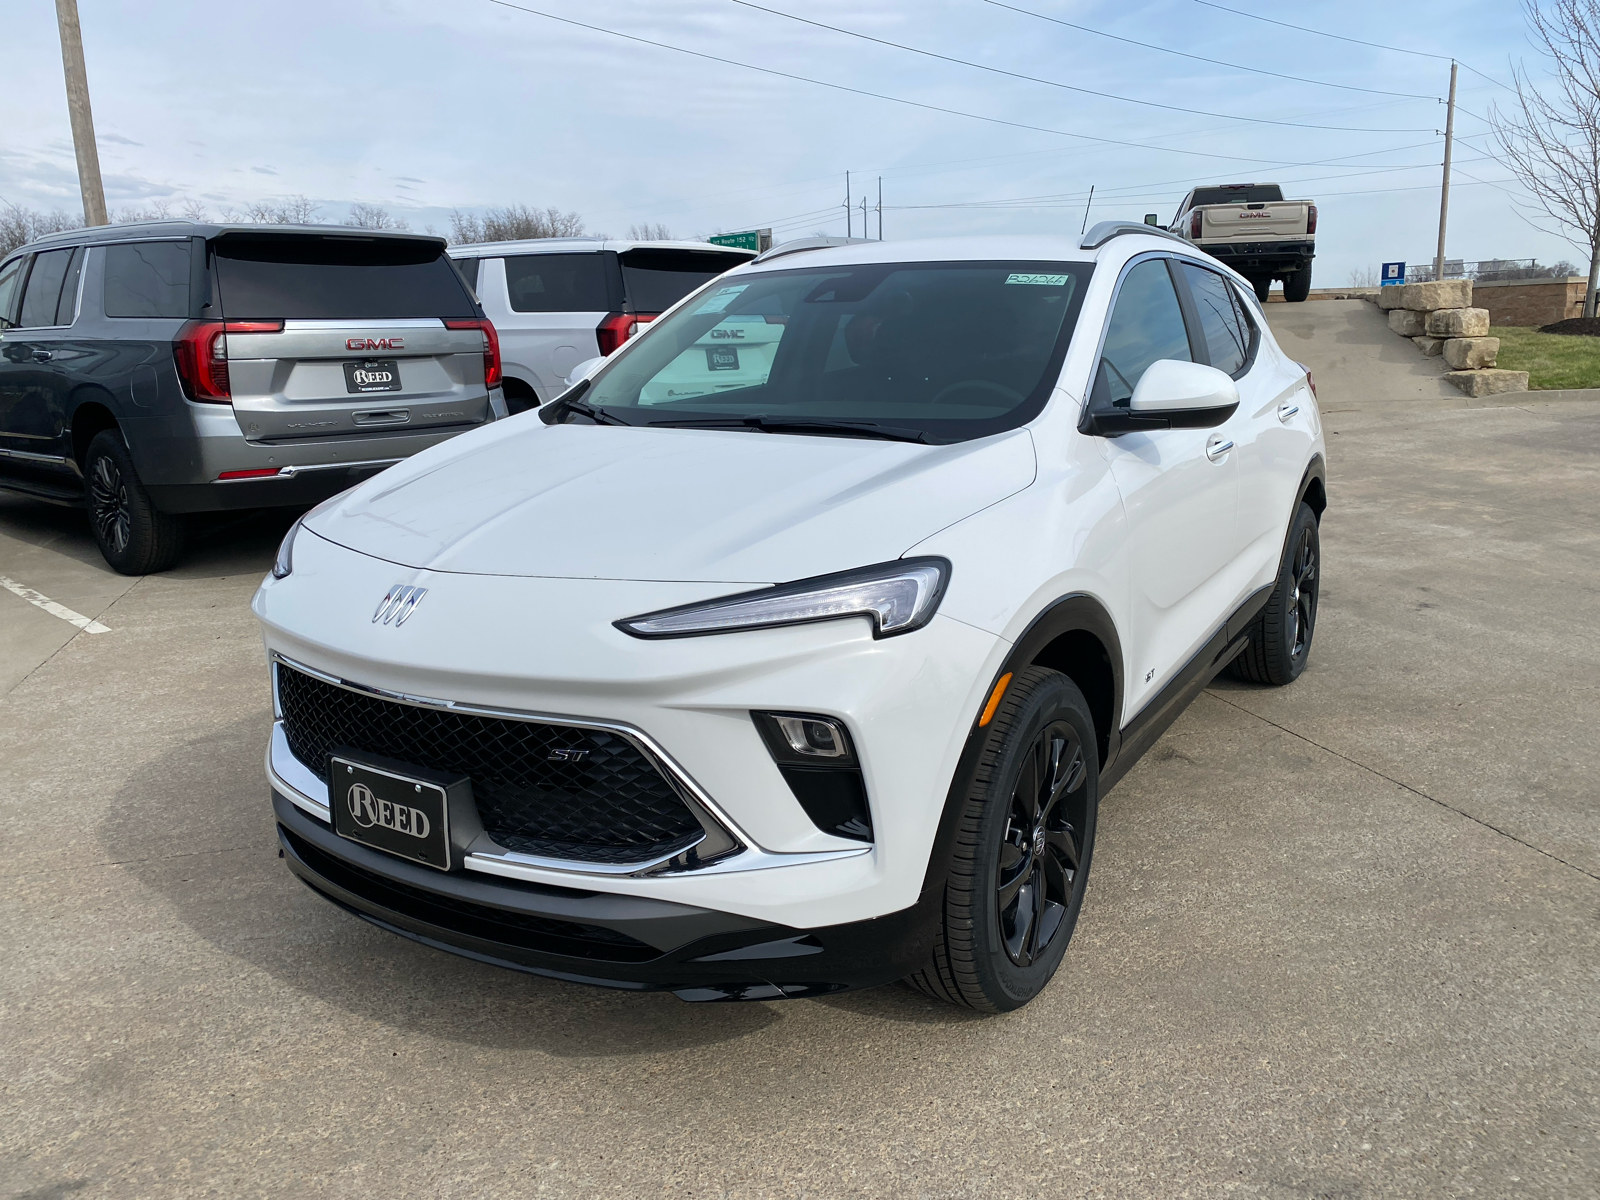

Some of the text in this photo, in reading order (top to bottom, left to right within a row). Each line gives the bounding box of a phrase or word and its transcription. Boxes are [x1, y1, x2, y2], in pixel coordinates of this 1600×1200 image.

[1239, 211, 1272, 219] GMC
[711, 329, 745, 339] GMC
[346, 337, 405, 351] GMC
[713, 353, 735, 365] REED
[353, 369, 393, 386] REED
[547, 748, 590, 763] ST
[347, 782, 431, 840] REED
